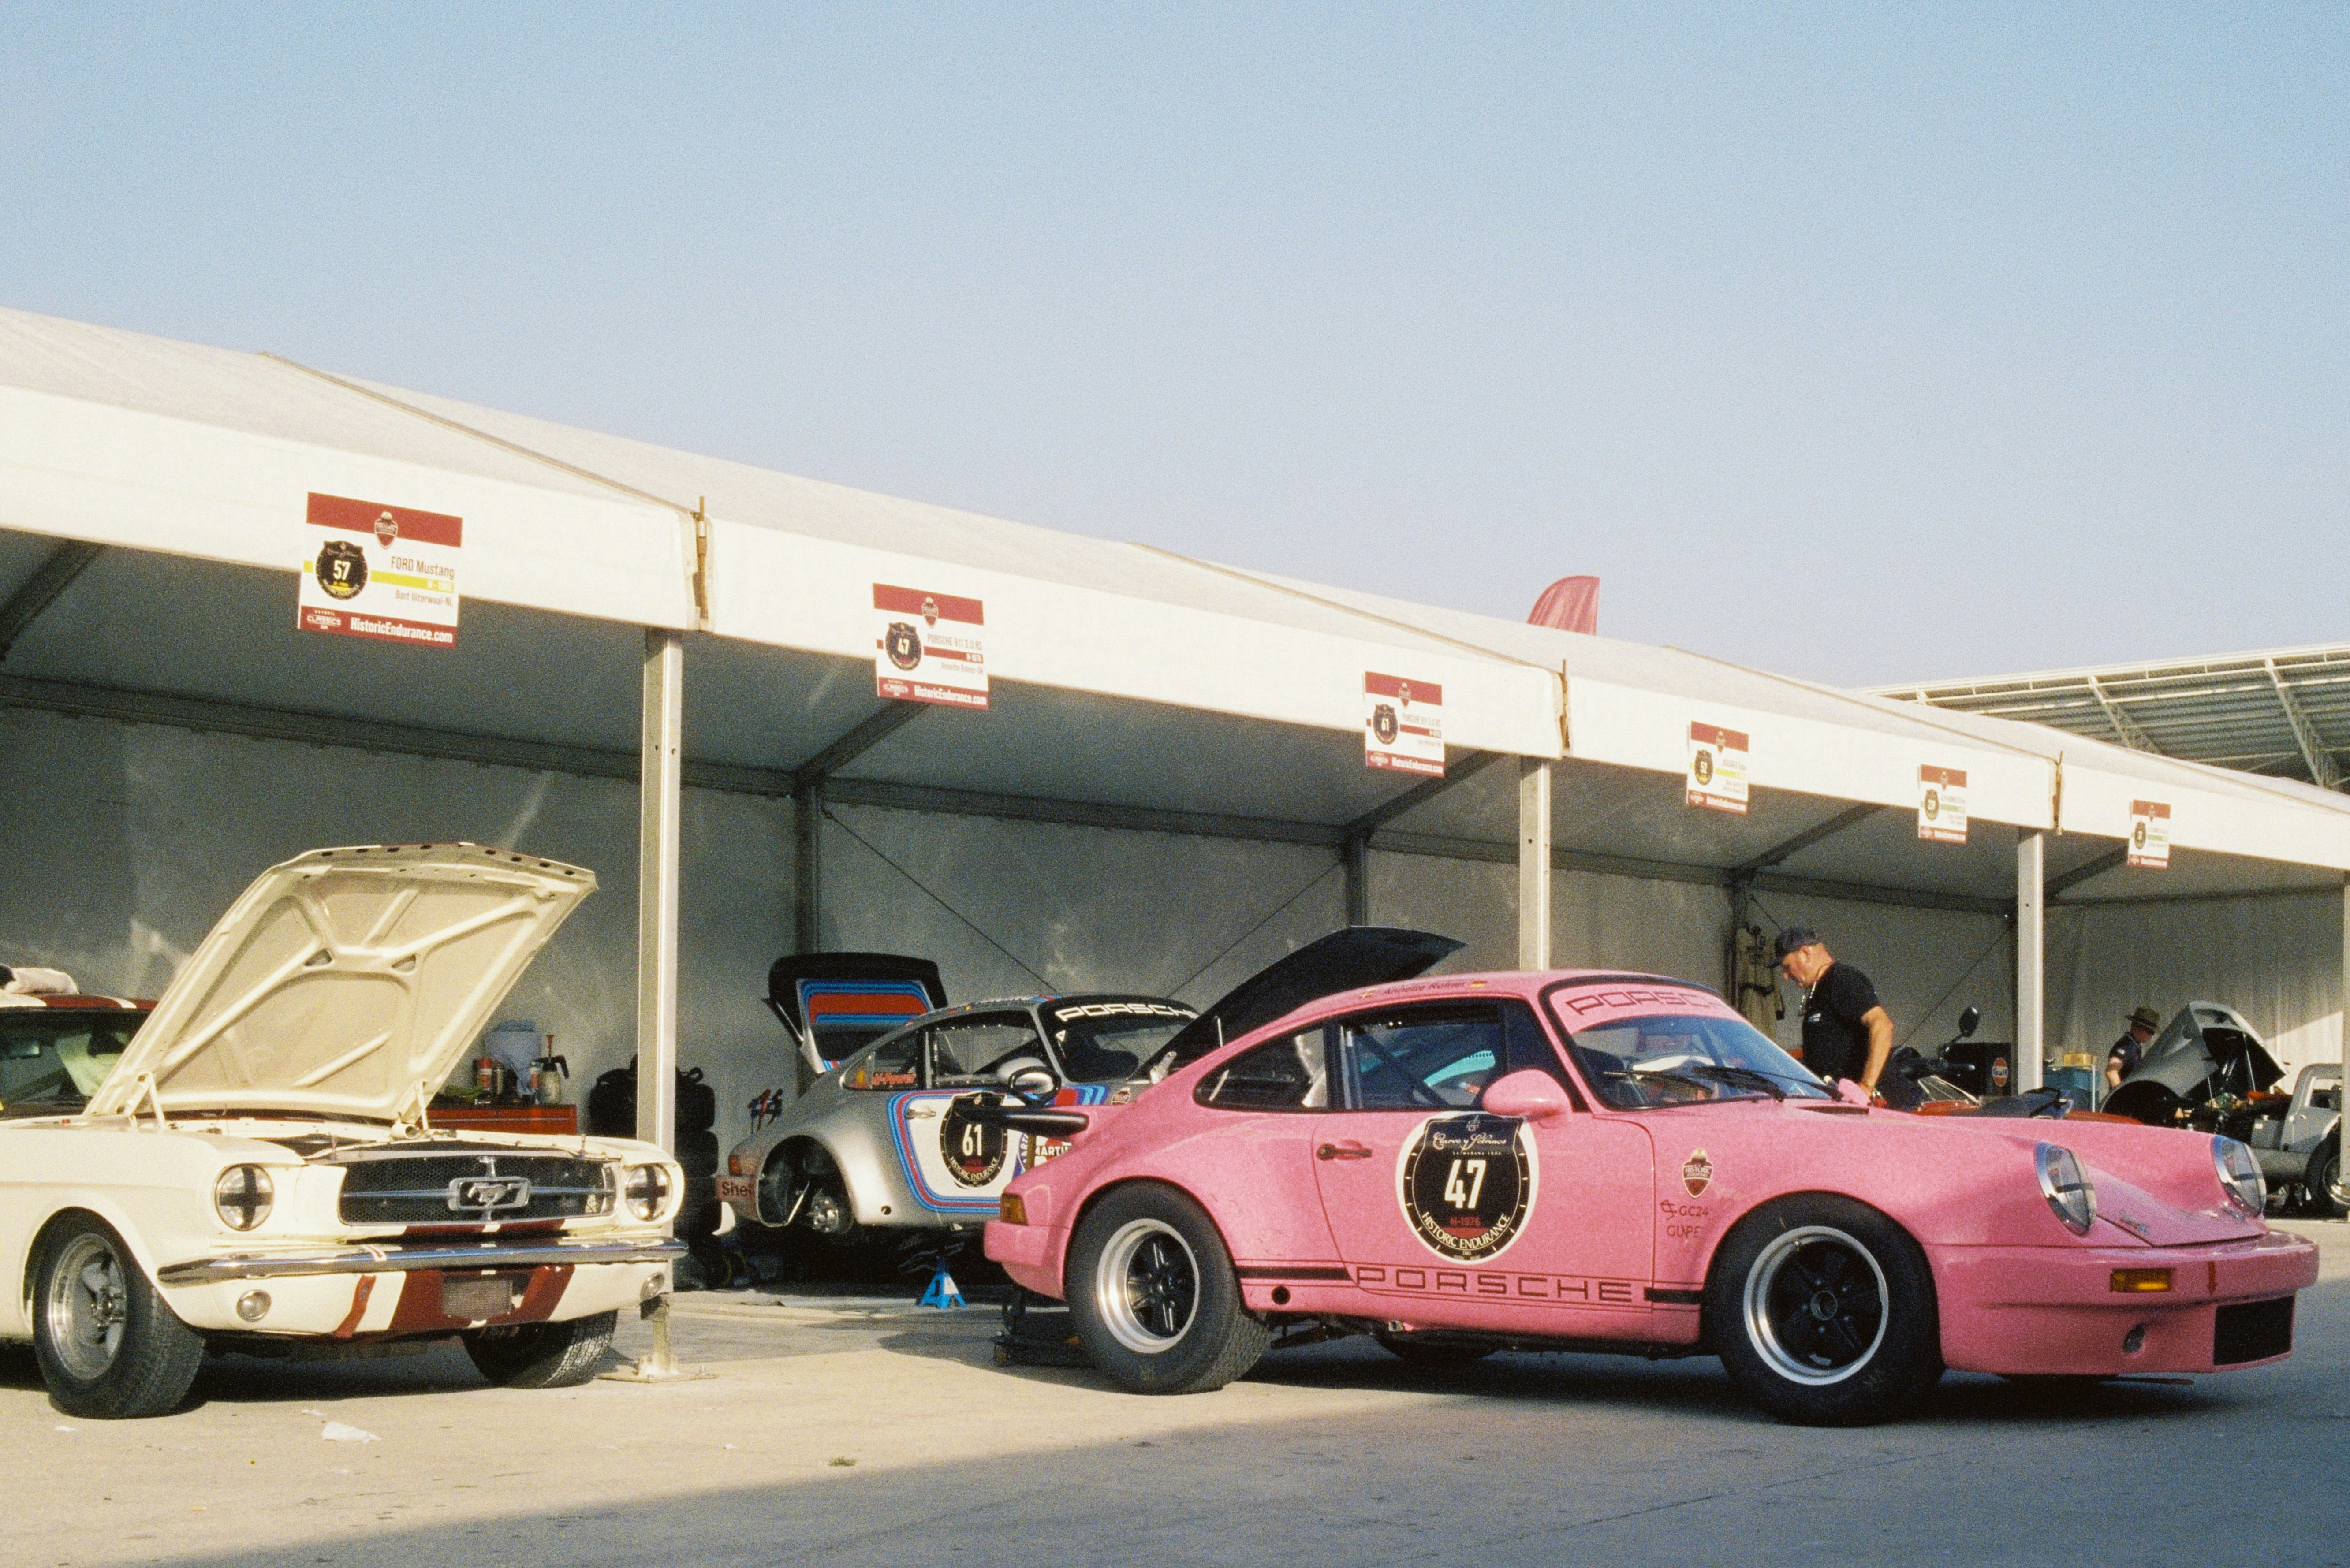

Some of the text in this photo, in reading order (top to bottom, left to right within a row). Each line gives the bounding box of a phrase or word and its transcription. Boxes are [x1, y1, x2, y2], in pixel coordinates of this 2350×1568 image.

[334, 559, 351, 581] 57
[391, 556, 455, 581] FORD Mustang
[351, 617, 453, 643] HistoricEndurance.com
[927, 633, 952, 646] PORSCHE
[897, 638, 910, 655] 47
[963, 1124, 982, 1156] 61
[1444, 1159, 1487, 1209] 47
[1422, 1211, 1511, 1249] HISTORIC ENDURANCE
[1355, 1266, 1632, 1302] PORSCHE
